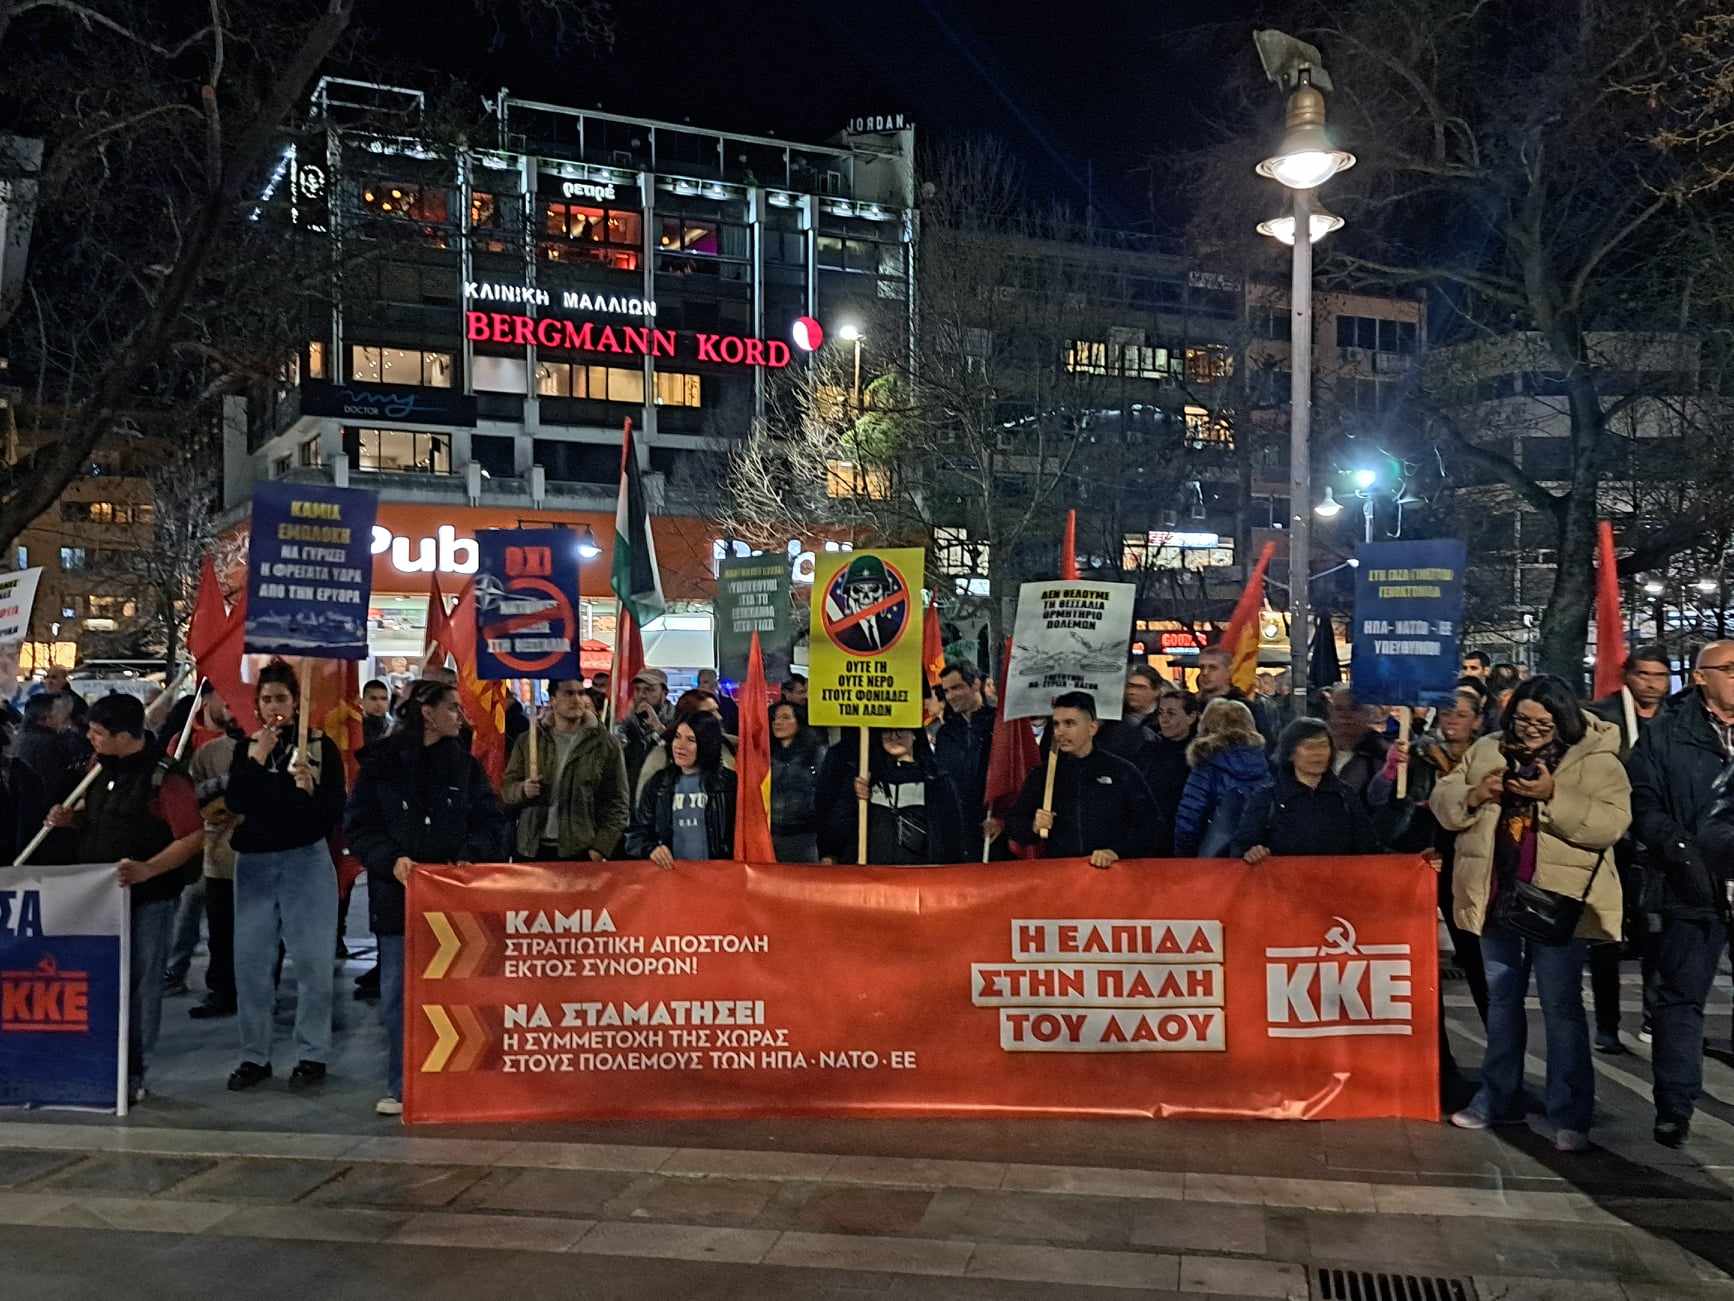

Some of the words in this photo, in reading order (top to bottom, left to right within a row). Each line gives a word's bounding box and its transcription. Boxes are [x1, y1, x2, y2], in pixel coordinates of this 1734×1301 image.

[463, 281, 549, 306] ΚΛΙΝΙΚΗ
[563, 291, 657, 317] ΜΑΛΛΙΩΝ
[466, 311, 676, 357] BERGMANN
[696, 333, 790, 367] KORD
[281, 545, 299, 559] ΝΑ
[260, 562, 270, 577] Η
[273, 564, 328, 580] ΦΡΕΓΑΤΑ
[332, 568, 362, 583] ΥΔΡΑ
[258, 583, 285, 599] ΑΠΟ
[1041, 590, 1060, 600] ΔΕΝ
[1063, 590, 1110, 600] ΘΕΛΟΥΜΕ
[846, 660, 871, 673] ΟΥΤΕ
[874, 661, 887, 673] ΓΗ
[838, 675, 863, 688] ΟΥΤΕ
[867, 675, 894, 688] ΝΕΡΟ
[822, 689, 852, 702] ΣΤΟΥΣ
[839, 703, 859, 716] ΤΩΝ
[505, 907, 617, 934] ΚΑΜΙΑ
[504, 936, 645, 956] ΣΤΡΑΤΙΩΤΙΚΗ
[650, 934, 769, 954] ΑΠΟΣΤΟΛΗ
[1018, 925, 1046, 954] Η
[1057, 925, 1214, 954] ΕΛΠΙΔΑ
[504, 959, 576, 978] ΕΚΤΟΣ
[581, 956, 698, 977] ΣΥΝΟΡΩΝ!
[977, 968, 1085, 998] ΣΤΗΝ
[1096, 968, 1214, 998] ΠΑΛΗ
[1266, 959, 1413, 1023] ΚΚΕ
[2, 982, 88, 1023] ΚΚΕ
[503, 1003, 552, 1029] ΝΑ
[560, 1000, 765, 1027] ΣΤΑΜΑΤΗΣΕΙ
[1005, 1012, 1088, 1043] ΤΟΥ
[1098, 1013, 1215, 1043] ΛΑΟΥ
[503, 1033, 519, 1051] Η
[525, 1030, 663, 1051] ΣΥΜΜΕΤΟΧΗ
[669, 1029, 711, 1048] ΤΗΣ
[716, 1029, 789, 1048] ΧΩΡΑΣ
[502, 1053, 574, 1073] ΣΤΟΥΣ
[579, 1051, 703, 1071] ΠΟΛΕΜΟΥΣ
[710, 1051, 755, 1069] ΤΩΝ
